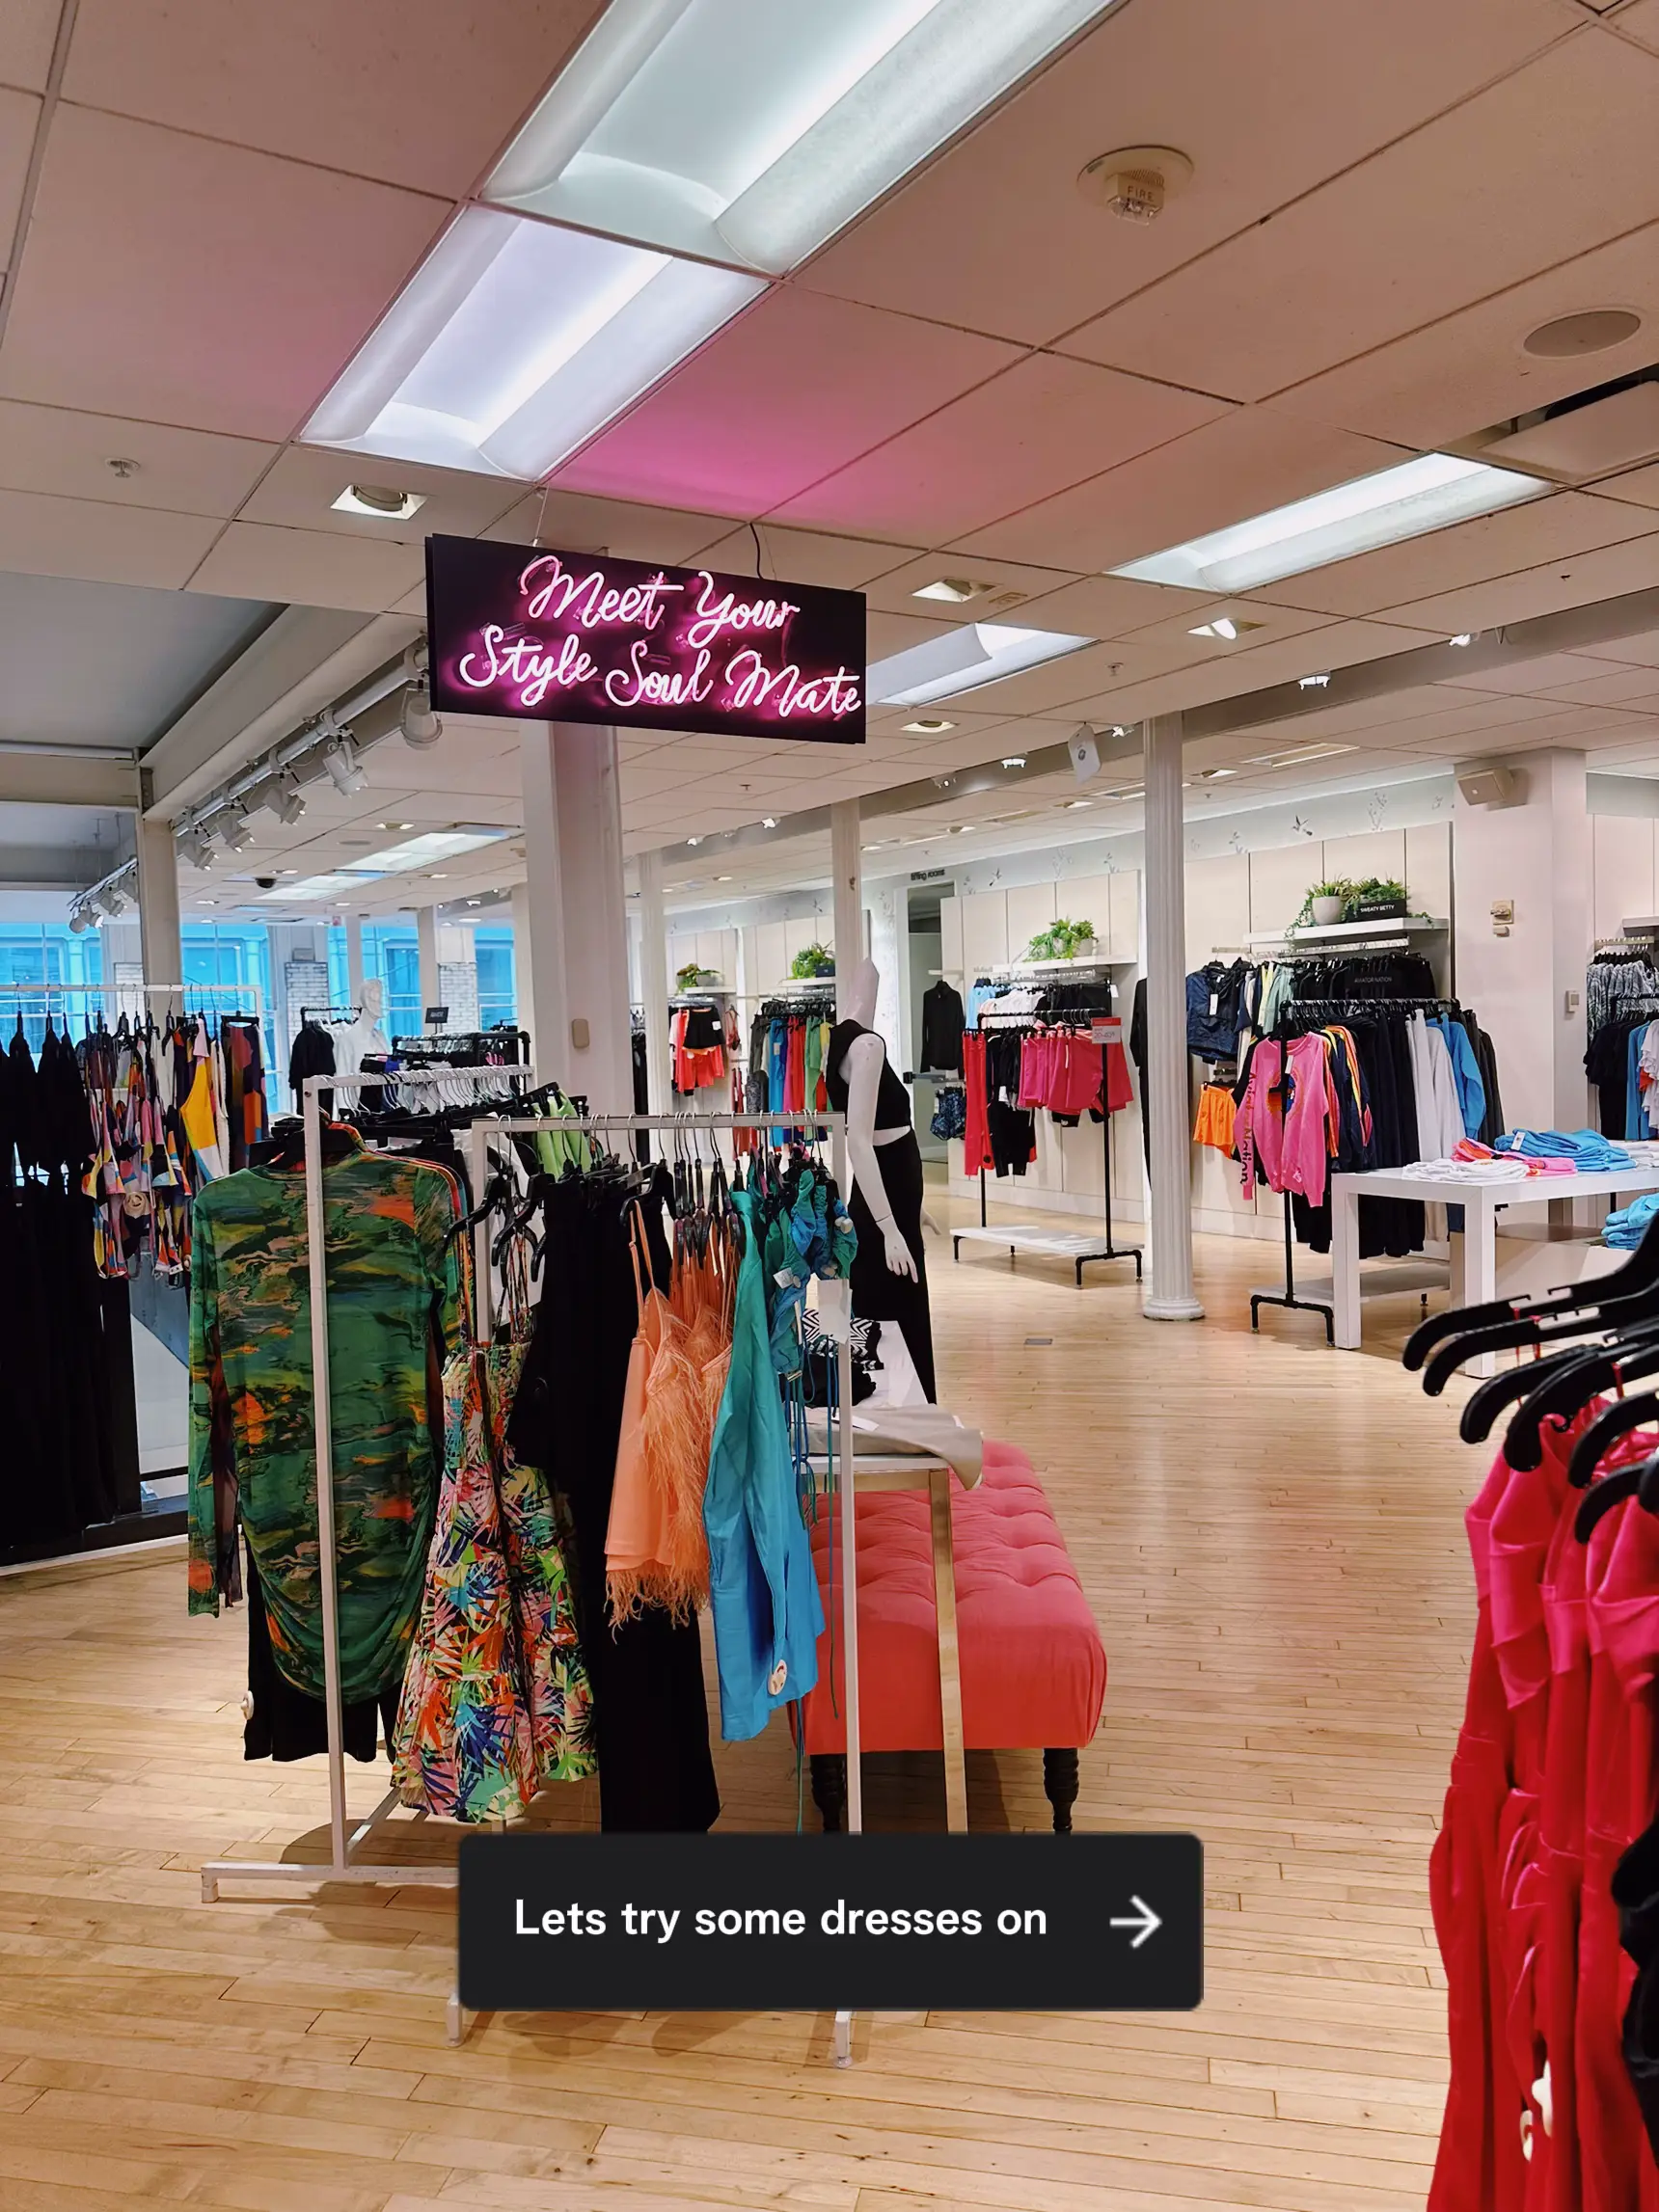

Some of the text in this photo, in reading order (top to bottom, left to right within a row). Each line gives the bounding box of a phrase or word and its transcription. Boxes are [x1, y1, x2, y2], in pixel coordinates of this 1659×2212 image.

[1127, 185, 1155, 202] FIRE
[519, 554, 801, 649] Meet Your
[458, 625, 862, 718] Style Soul Mate
